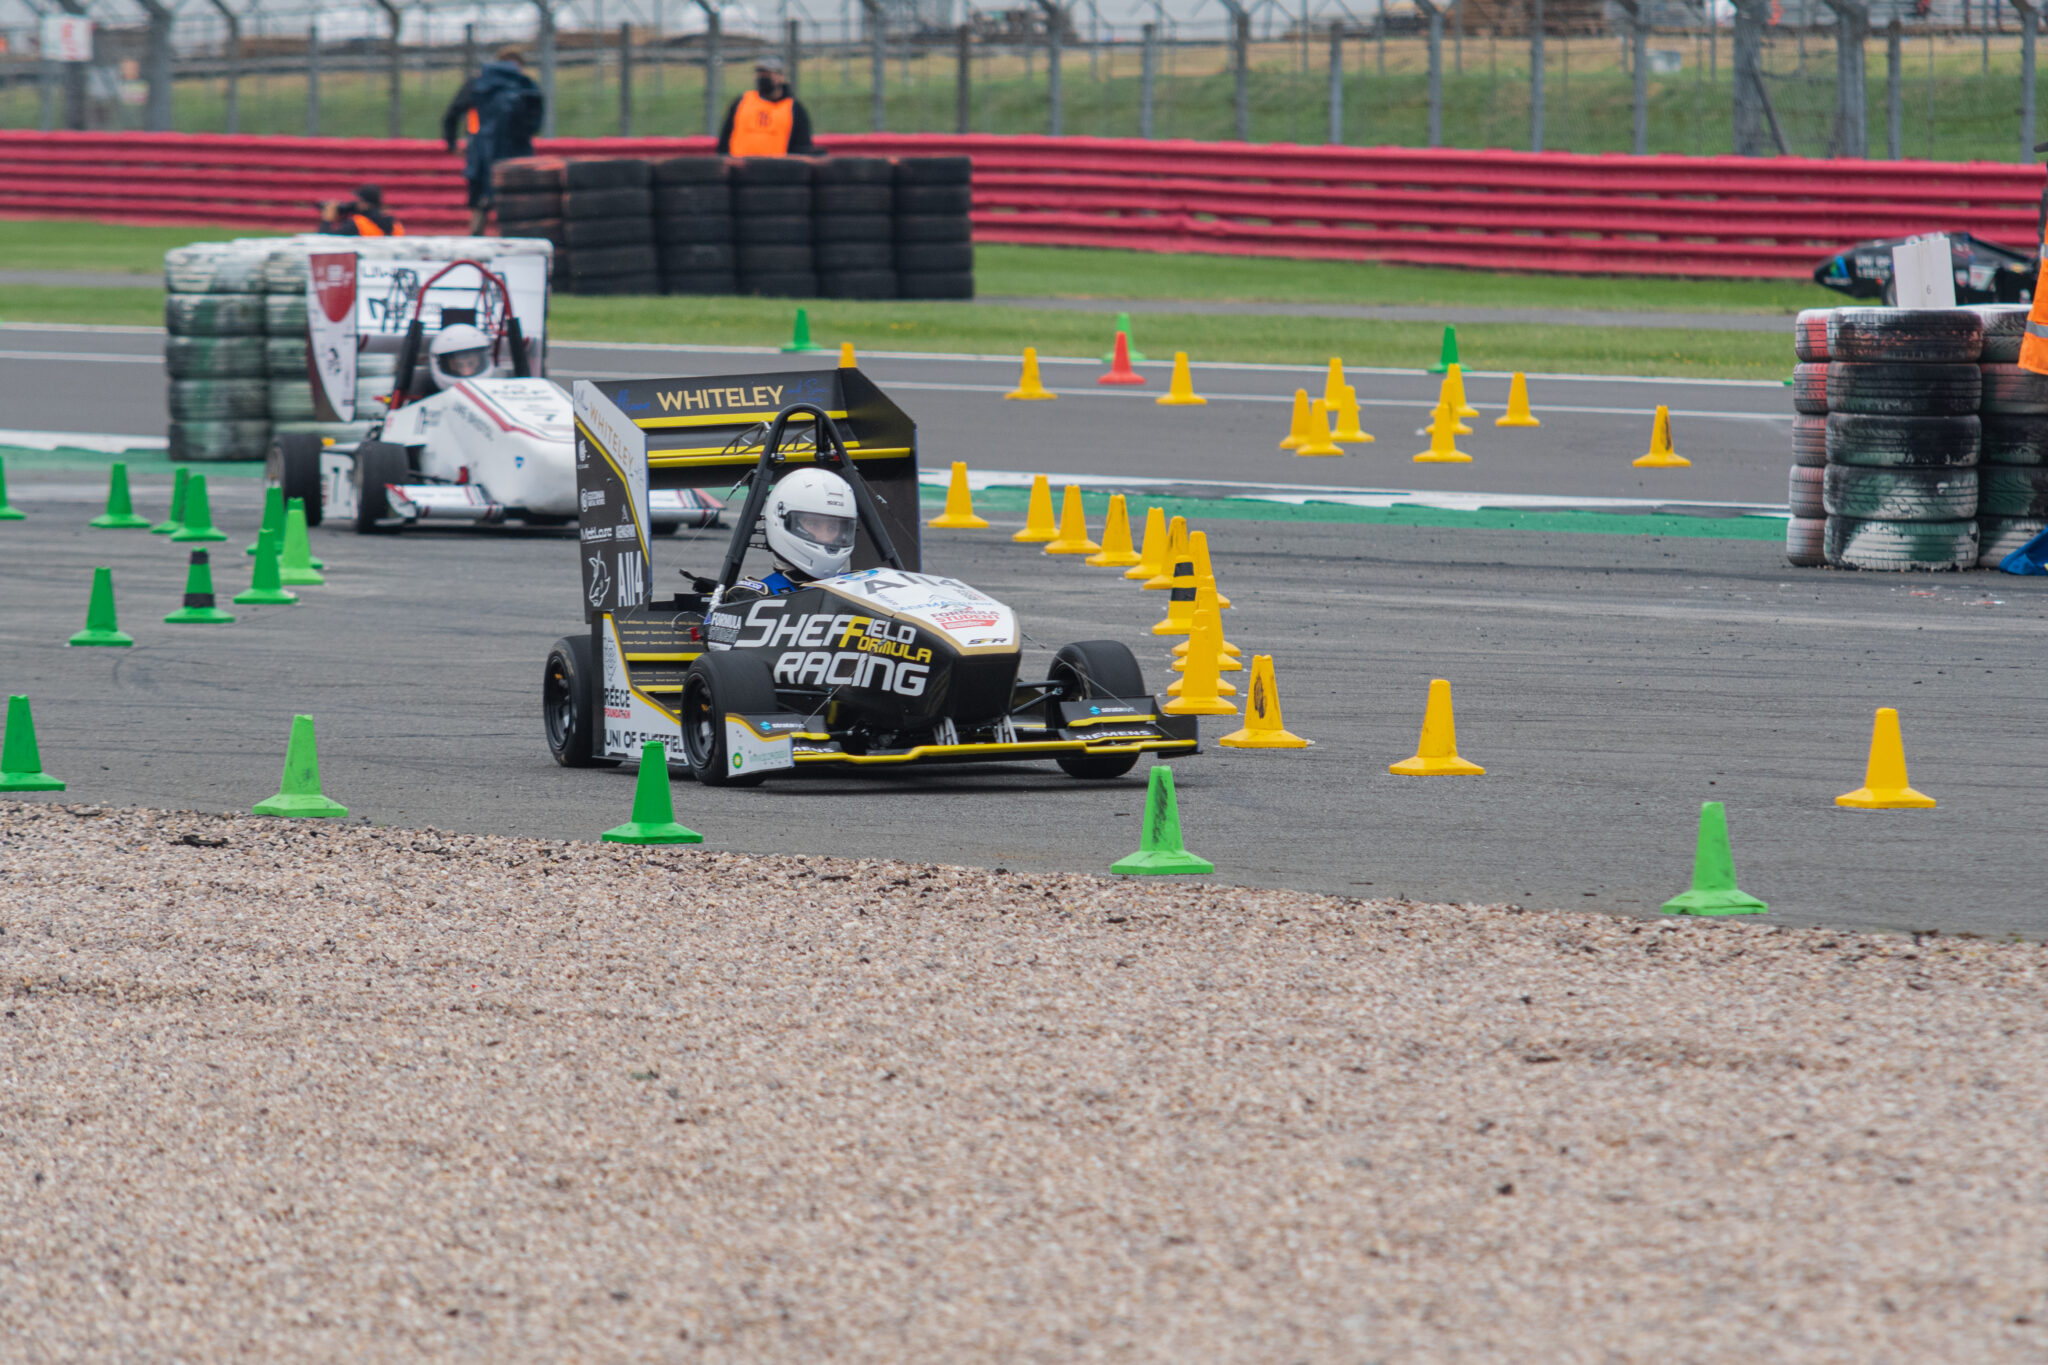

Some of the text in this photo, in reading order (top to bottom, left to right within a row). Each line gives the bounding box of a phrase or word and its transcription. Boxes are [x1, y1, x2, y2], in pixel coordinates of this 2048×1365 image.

[656, 385, 783, 412] WHITELEY
[589, 401, 634, 472] WHITELEY
[734, 599, 917, 648] SHEFFIELD
[773, 651, 930, 697] RACING
[605, 687, 631, 708] REECE
[624, 730, 637, 749] OF
[1076, 730, 1152, 740] SIEMENS
